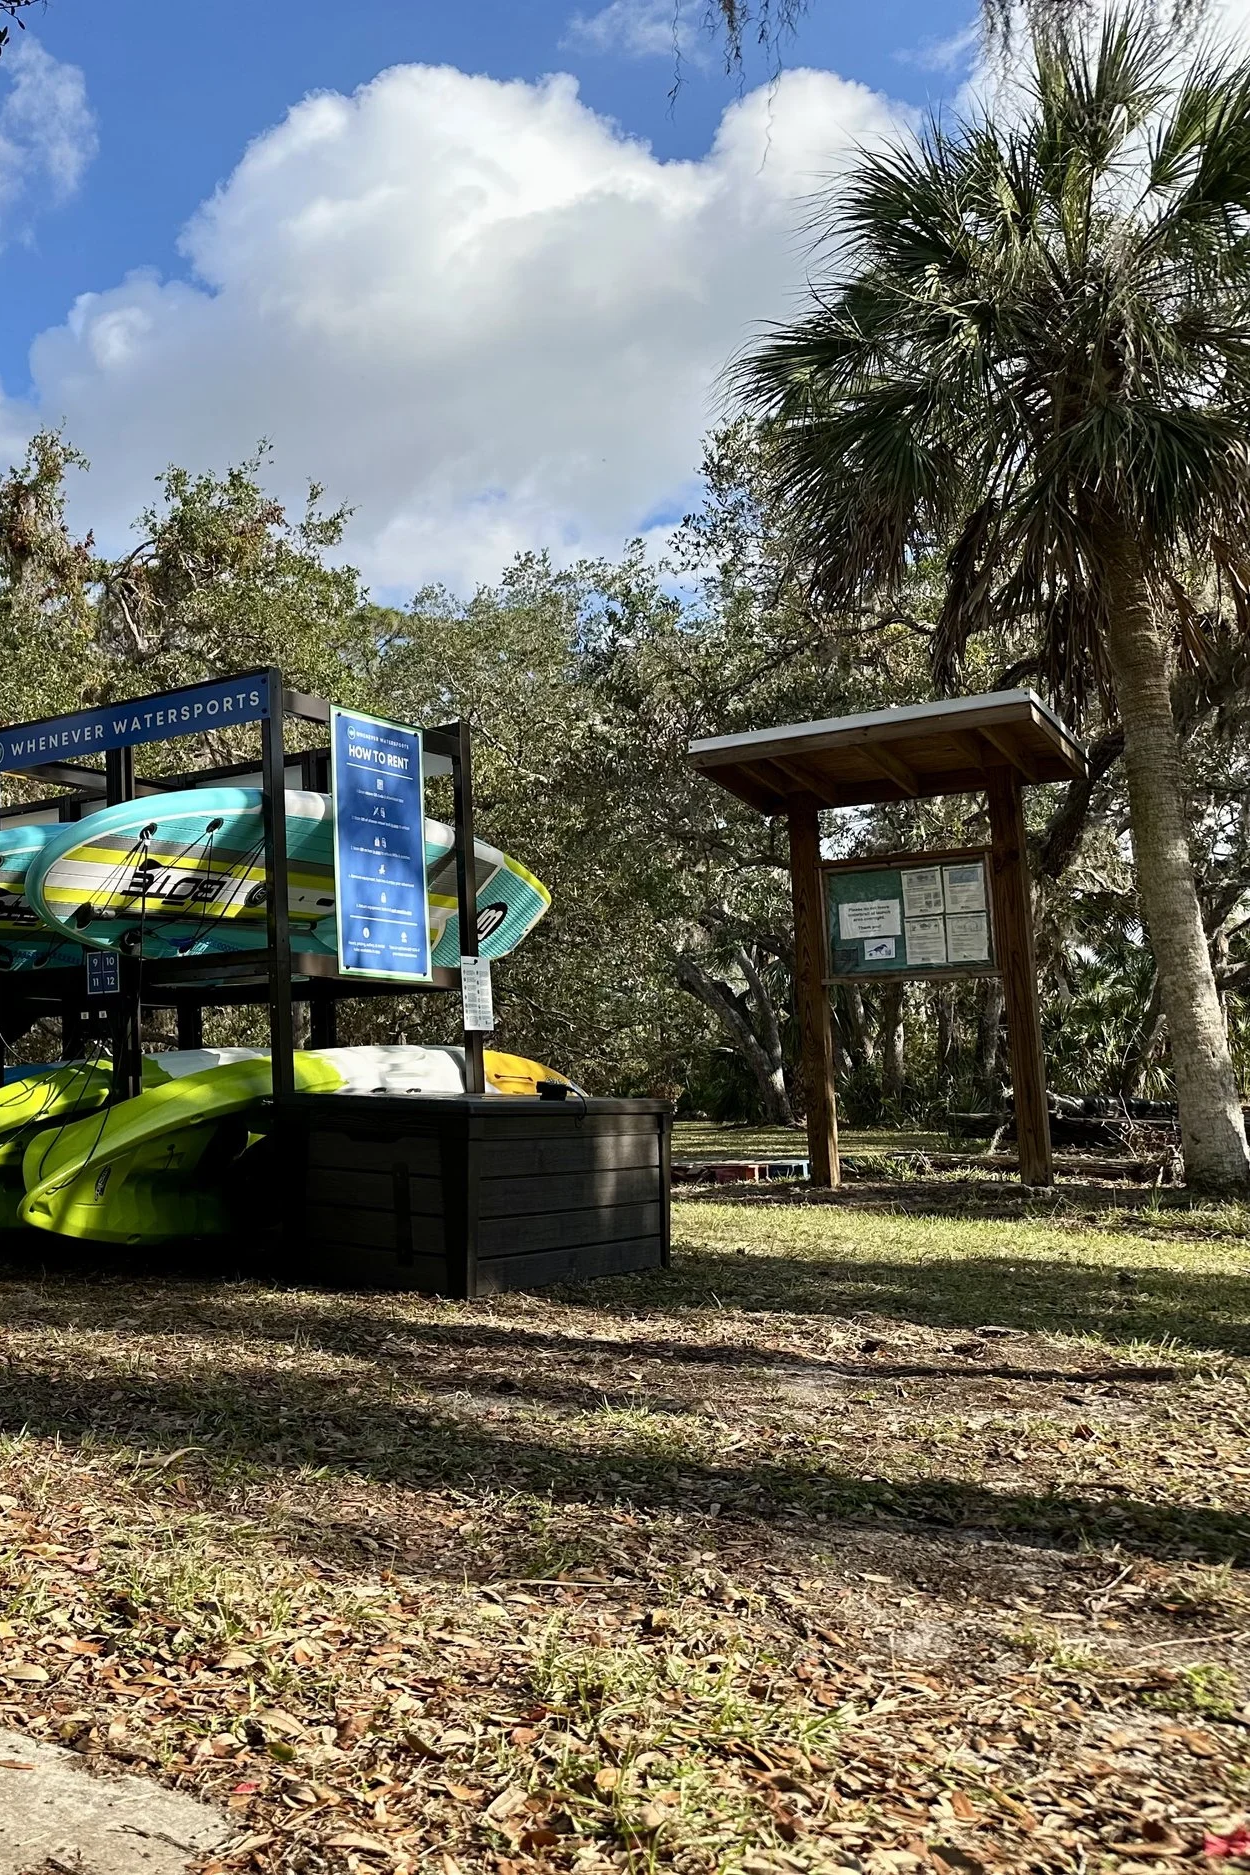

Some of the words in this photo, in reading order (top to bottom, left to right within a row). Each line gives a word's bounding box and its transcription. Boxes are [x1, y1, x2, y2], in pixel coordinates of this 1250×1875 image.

[10, 724, 105, 757] WHENEVER
[113, 690, 260, 734] WATERSPORTS
[380, 737, 409, 750] WATERSPORTS
[348, 743, 372, 761] HOW
[373, 750, 386, 765] TO
[387, 753, 409, 770] RENT
[93, 958, 98, 967] 9
[106, 957, 115, 966] 10
[92, 977, 99, 987] 11
[106, 976, 115, 985] 12
